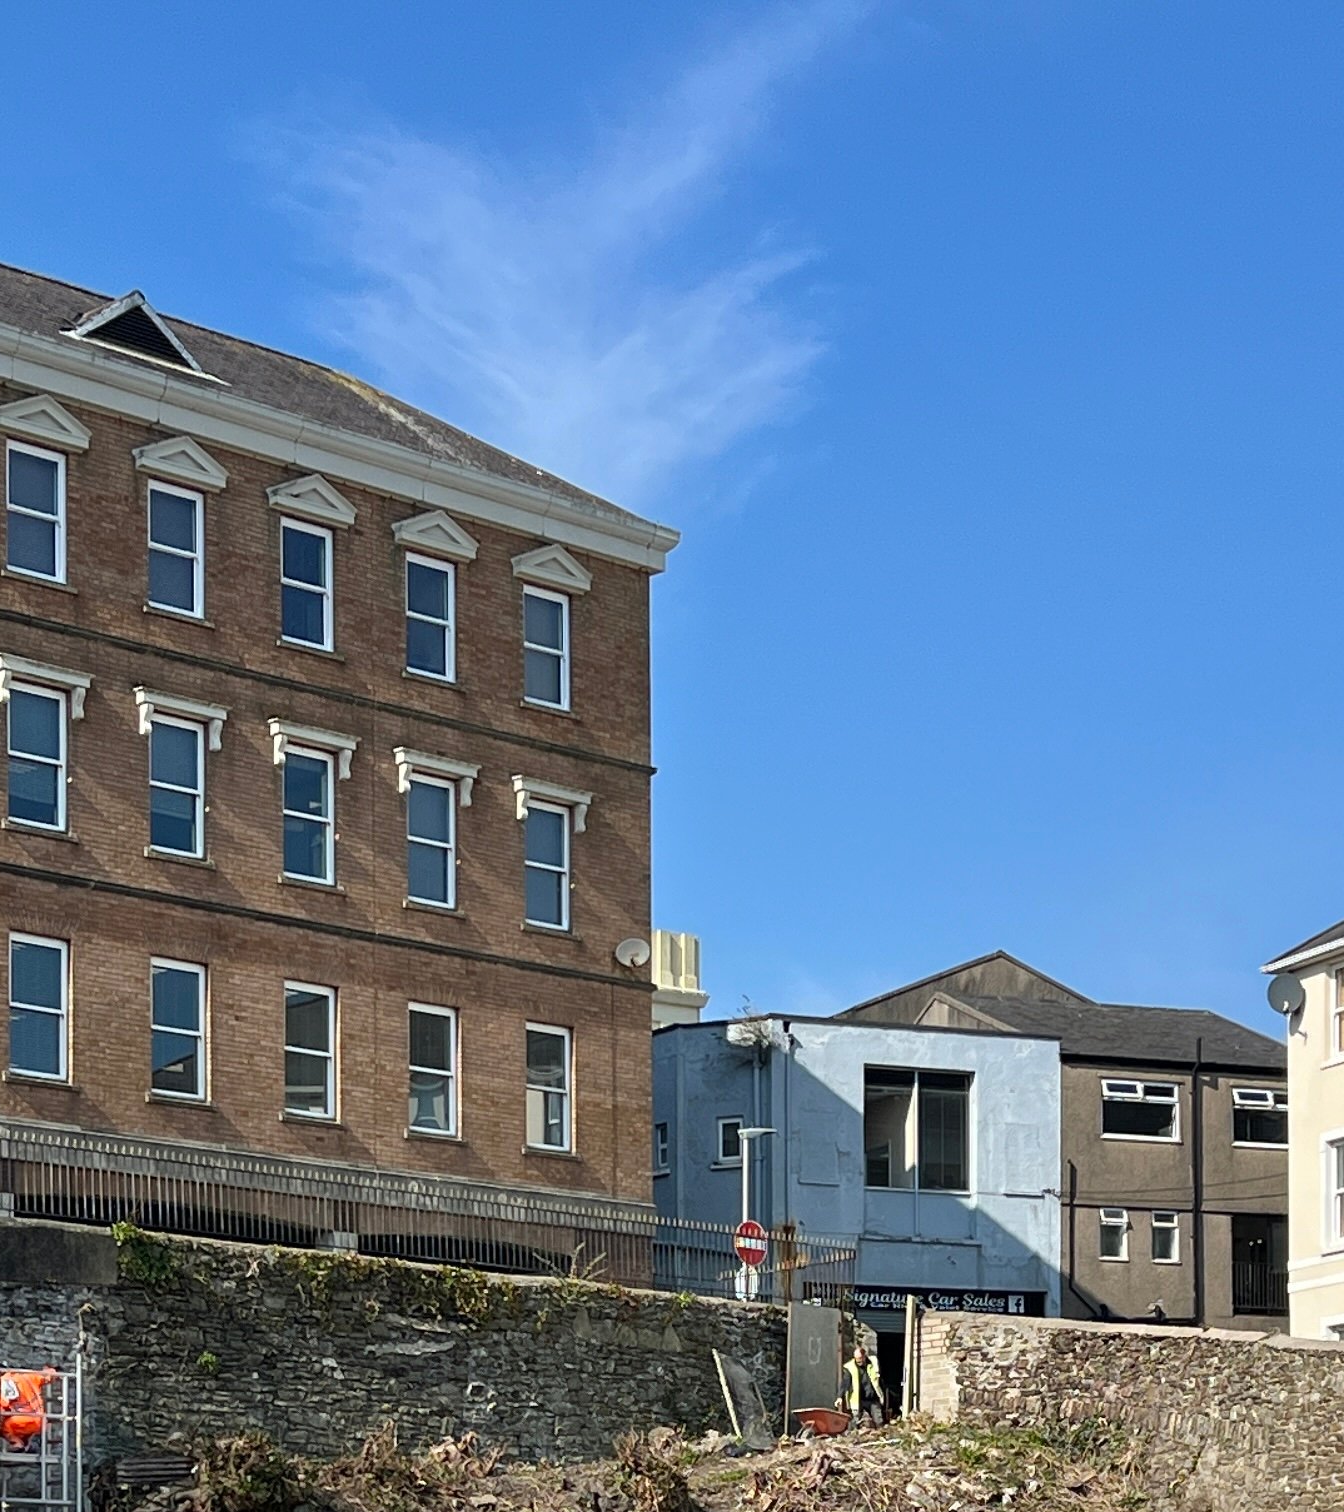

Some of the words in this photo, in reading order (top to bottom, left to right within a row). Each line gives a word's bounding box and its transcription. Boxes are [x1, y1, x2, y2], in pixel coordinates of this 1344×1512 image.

[843, 1287, 923, 1308] Signatue
[928, 1291, 959, 1305] Car
[962, 1292, 1005, 1307] Sales
